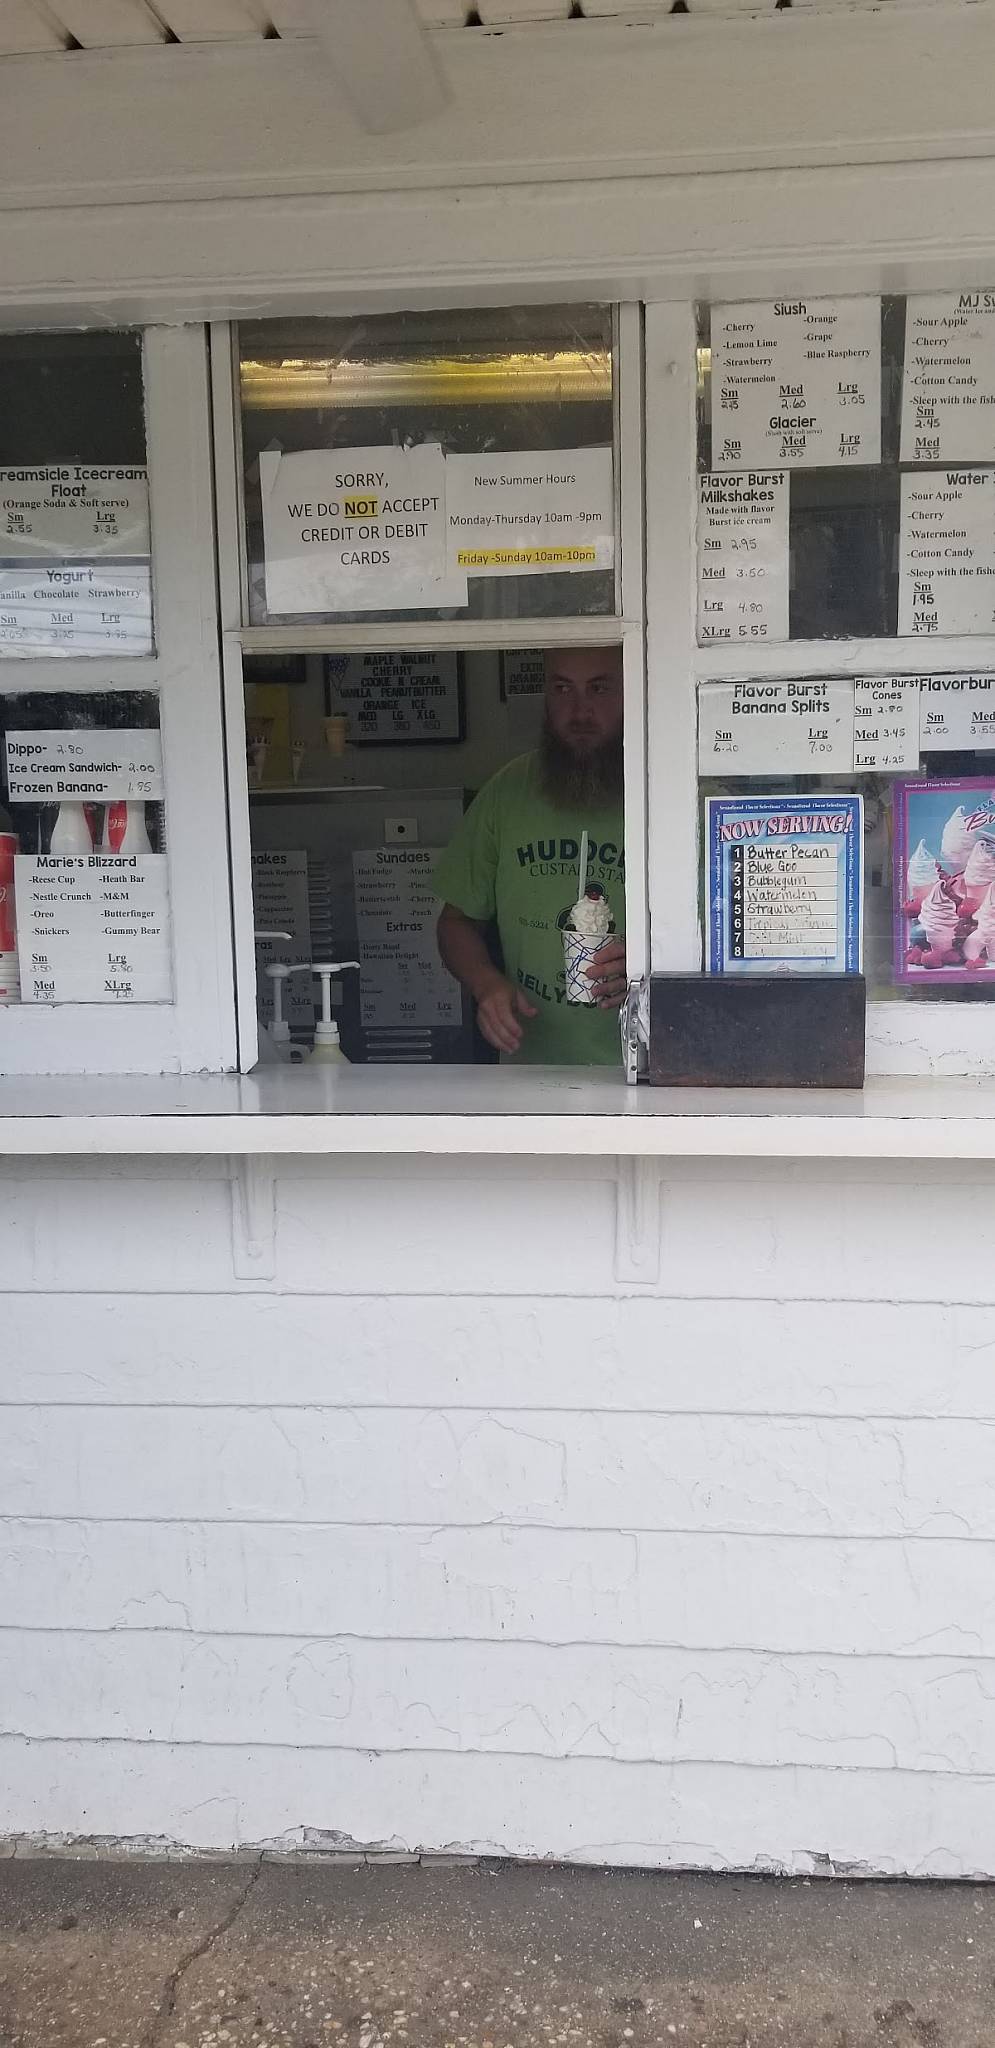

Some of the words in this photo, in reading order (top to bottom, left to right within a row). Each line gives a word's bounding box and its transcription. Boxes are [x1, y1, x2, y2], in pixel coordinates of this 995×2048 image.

[959, 295, 979, 307] MJ
[803, 315, 838, 324] -Orange
[913, 318, 938, 327] -Sour
[940, 317, 968, 328] Apple
[722, 323, 755, 332] -Cherry
[803, 333, 832, 342] -Grape
[912, 337, 949, 349] -Cherry
[722, 341, 754, 349] -Lemon
[803, 351, 825, 359] -Blue
[828, 349, 871, 358] Raspberry
[723, 358, 773, 367] -Strawberry
[912, 356, 971, 366] -Watermelon
[723, 375, 776, 384] -Watermelon
[910, 376, 945, 385] -Cotton
[948, 375, 978, 387] Candy
[721, 388, 739, 399] Sm
[837, 382, 859, 393] Lrg
[909, 396, 937, 406] -Sleep
[939, 396, 960, 405] with
[962, 396, 977, 404] the
[769, 416, 816, 429] Glacier
[915, 418, 940, 429] 2.45
[724, 439, 741, 449] Sm
[840, 434, 860, 445] Lrg
[912, 450, 940, 459] 3.35
[0, 468, 70, 481] reamsicle
[74, 467, 147, 480] Icecream
[946, 473, 989, 485] Water
[334, 472, 389, 489] SORRY,
[474, 475, 497, 487] New
[500, 474, 543, 486] Summer
[546, 473, 576, 485] Hours
[700, 475, 743, 488] Flavor
[749, 473, 785, 485] Burst
[51, 484, 87, 497] Float
[908, 491, 933, 500] -Sour
[935, 490, 963, 501] Apple
[701, 490, 774, 503] Milkshakes
[3, 500, 41, 509] (Orange
[43, 500, 66, 508] Soda
[80, 499, 99, 507] Soft
[101, 499, 129, 508] serve)
[287, 503, 313, 518] WE
[317, 502, 340, 517] DO
[344, 500, 378, 518] NOT
[382, 497, 440, 514] ACCEPT
[706, 507, 729, 515] Made
[731, 506, 748, 514] with
[750, 505, 775, 513] flavor
[7, 512, 24, 521] Sm
[450, 512, 541, 527] Monday-Thursday
[544, 512, 573, 523] 10am
[575, 511, 602, 525] -9pm
[709, 518, 732, 526] Burst
[733, 517, 745, 525] ice
[908, 511, 944, 521] -Cherry
[301, 526, 353, 542] CREDIT
[358, 525, 380, 540] OR
[384, 523, 428, 539] DEBIT
[907, 530, 967, 539] -Watermelon
[704, 538, 722, 548] Sm
[731, 539, 757, 550] 2.95
[340, 551, 390, 566] CARDS
[457, 553, 489, 565] Friday
[491, 552, 532, 564] -Sunday
[534, 550, 596, 562] 10am-10pm
[907, 550, 941, 558] -Cotton
[944, 548, 974, 559] Candy
[47, 570, 94, 584] Yogurt
[736, 568, 765, 578] 3.50
[906, 568, 934, 578] -Sleep
[937, 568, 957, 576] with
[959, 568, 974, 576] the
[914, 582, 931, 592] Sm
[0, 591, 26, 600] anilla
[33, 590, 79, 599] Chocolate
[88, 589, 141, 599] Strawberry
[702, 626, 730, 637] XLrg
[855, 680, 887, 689] Flavor
[891, 679, 919, 688] Burst
[919, 677, 995, 691] Flavorbur
[734, 685, 782, 698] Flavor
[787, 683, 828, 696] Burst
[872, 691, 902, 700] Cones
[732, 701, 786, 714] Banana
[792, 700, 830, 716] Splits
[927, 712, 944, 723] Sm
[715, 730, 732, 740] Sm
[855, 729, 878, 739] Med
[883, 728, 905, 738] 3.45
[923, 726, 949, 735] 2.00
[8, 743, 47, 756] Dippo-
[9, 764, 27, 773] Ice
[31, 763, 65, 773] Cream
[69, 762, 122, 772] Sandwich-
[10, 782, 53, 793] Frozen
[57, 782, 108, 792] Banana-
[720, 819, 765, 842] NOW
[767, 813, 853, 836] SERVING!
[734, 848, 741, 858] 1
[747, 844, 787, 859] Butter
[791, 843, 829, 858] Pecan
[37, 857, 85, 868] Marie's
[88, 856, 137, 867] Blizzard
[376, 852, 430, 864] Sundaes
[734, 862, 741, 872] 2
[748, 861, 774, 873] Blue
[28, 876, 55, 884] -Reese
[58, 876, 75, 885] Cup
[99, 875, 128, 883] -Heath
[130, 875, 145, 883] Bar
[734, 876, 741, 886] 3
[747, 875, 807, 890] Bubblegum
[29, 893, 58, 901] -Nestle
[60, 892, 91, 900] Crunch
[100, 892, 129, 900] -M&M
[734, 890, 741, 900] 4
[30, 910, 54, 918] -Oreo
[100, 909, 155, 919] -Butterfinger
[734, 904, 741, 914] 5
[747, 902, 812, 915] Strawberry
[387, 922, 423, 932] Extras
[734, 918, 741, 928] 6
[32, 927, 70, 936] -Snickers
[101, 927, 138, 937] -Gummy
[141, 927, 160, 935] Bear
[734, 933, 741, 943] 7
[734, 946, 741, 956] 8
[32, 953, 48, 963] Sm
[33, 980, 55, 990] Med
